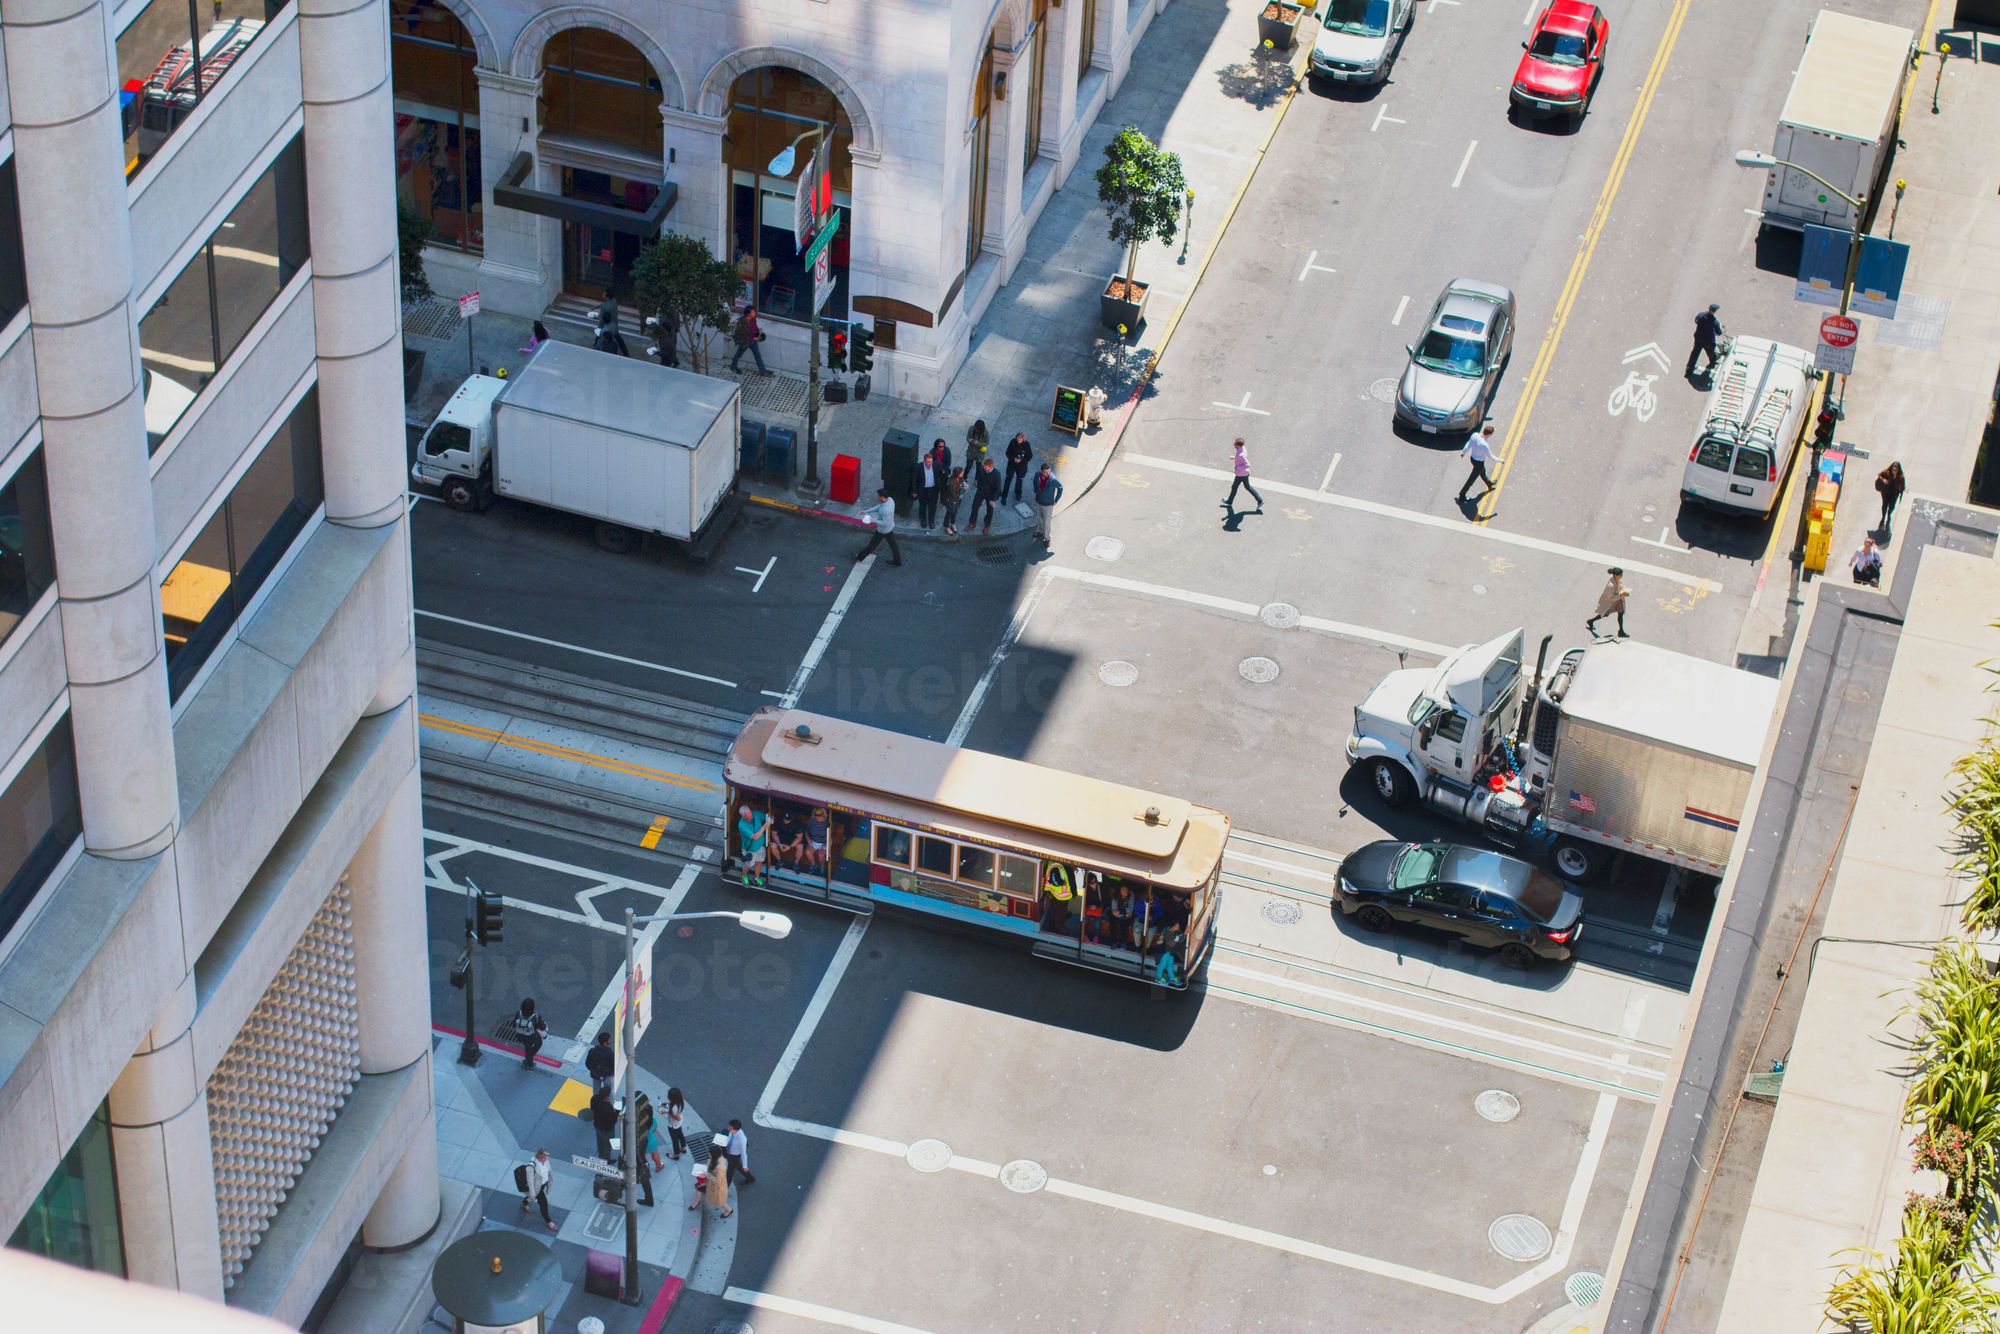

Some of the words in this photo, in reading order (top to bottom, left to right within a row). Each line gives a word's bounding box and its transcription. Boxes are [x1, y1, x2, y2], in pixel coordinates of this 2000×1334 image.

[1827, 333, 1849, 343] ENTER
[1831, 444, 1866, 458] ALIFORNIA
[827, 803, 853, 813] MARKET
[871, 813, 908, 826] CHINATOWN
[969, 836, 982, 844] VAN
[983, 840, 1000, 848] NESS
[1030, 850, 1072, 864] CALIFORNIA
[574, 1158, 620, 1176] CALIFORNIA
